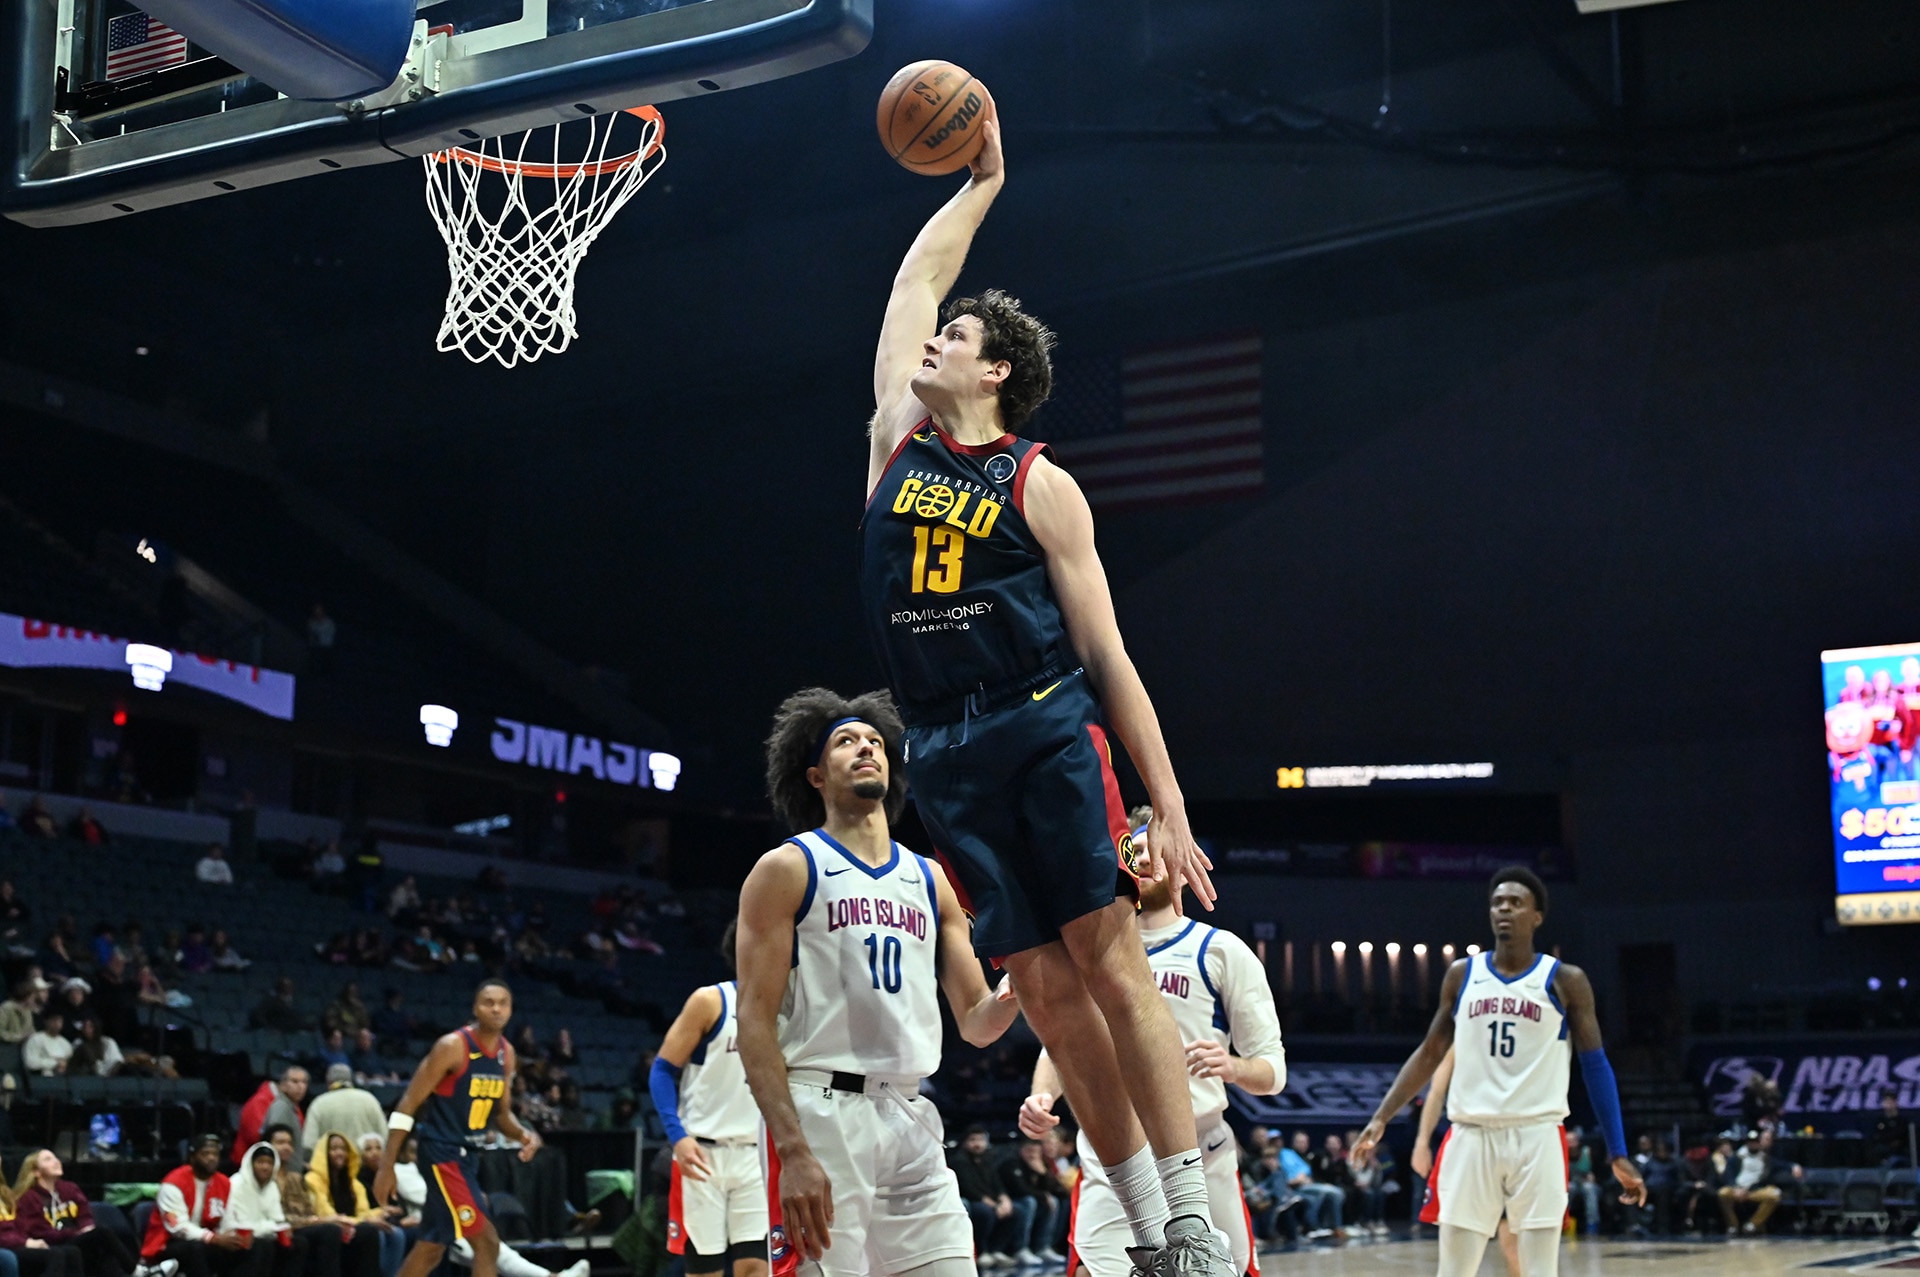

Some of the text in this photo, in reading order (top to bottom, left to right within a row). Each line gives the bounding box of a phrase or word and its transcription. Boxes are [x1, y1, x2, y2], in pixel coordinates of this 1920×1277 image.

[923, 92, 982, 149] Wilson
[907, 469, 1006, 505] GRAND RAPIDS
[892, 478, 1002, 538] GOLD
[911, 524, 965, 594] 13
[891, 602, 994, 625] ATOMICHONEY
[912, 622, 970, 634] MARKETNG
[827, 897, 927, 942] LONG ISLAND
[864, 933, 902, 994] 10
[1153, 971, 1190, 1000] AND
[1468, 996, 1542, 1022] LONG ISLAND
[1487, 1020, 1517, 1058] 15
[1795, 1055, 1890, 1087] NBA
